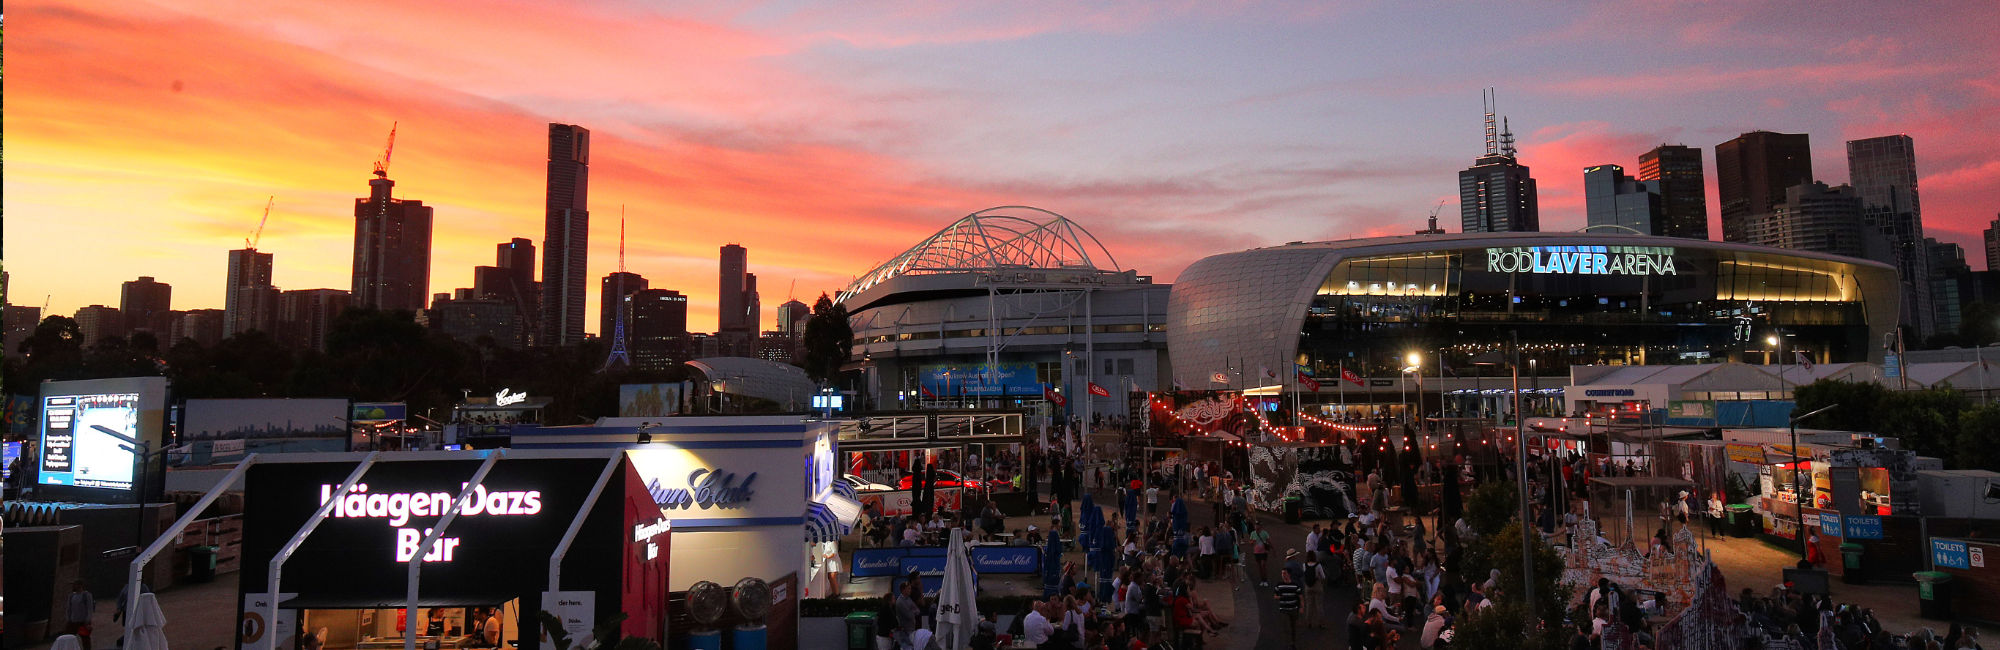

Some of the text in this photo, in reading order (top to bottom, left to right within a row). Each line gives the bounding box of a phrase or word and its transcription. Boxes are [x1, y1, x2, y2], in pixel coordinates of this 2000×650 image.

[1585, 389, 1614, 397] COUNTRY
[1847, 517, 1879, 525] TOILETS
[1934, 541, 1965, 552] TOILETS
[976, 554, 1032, 566] Canadian Club
[907, 565, 945, 576] Cnadian
